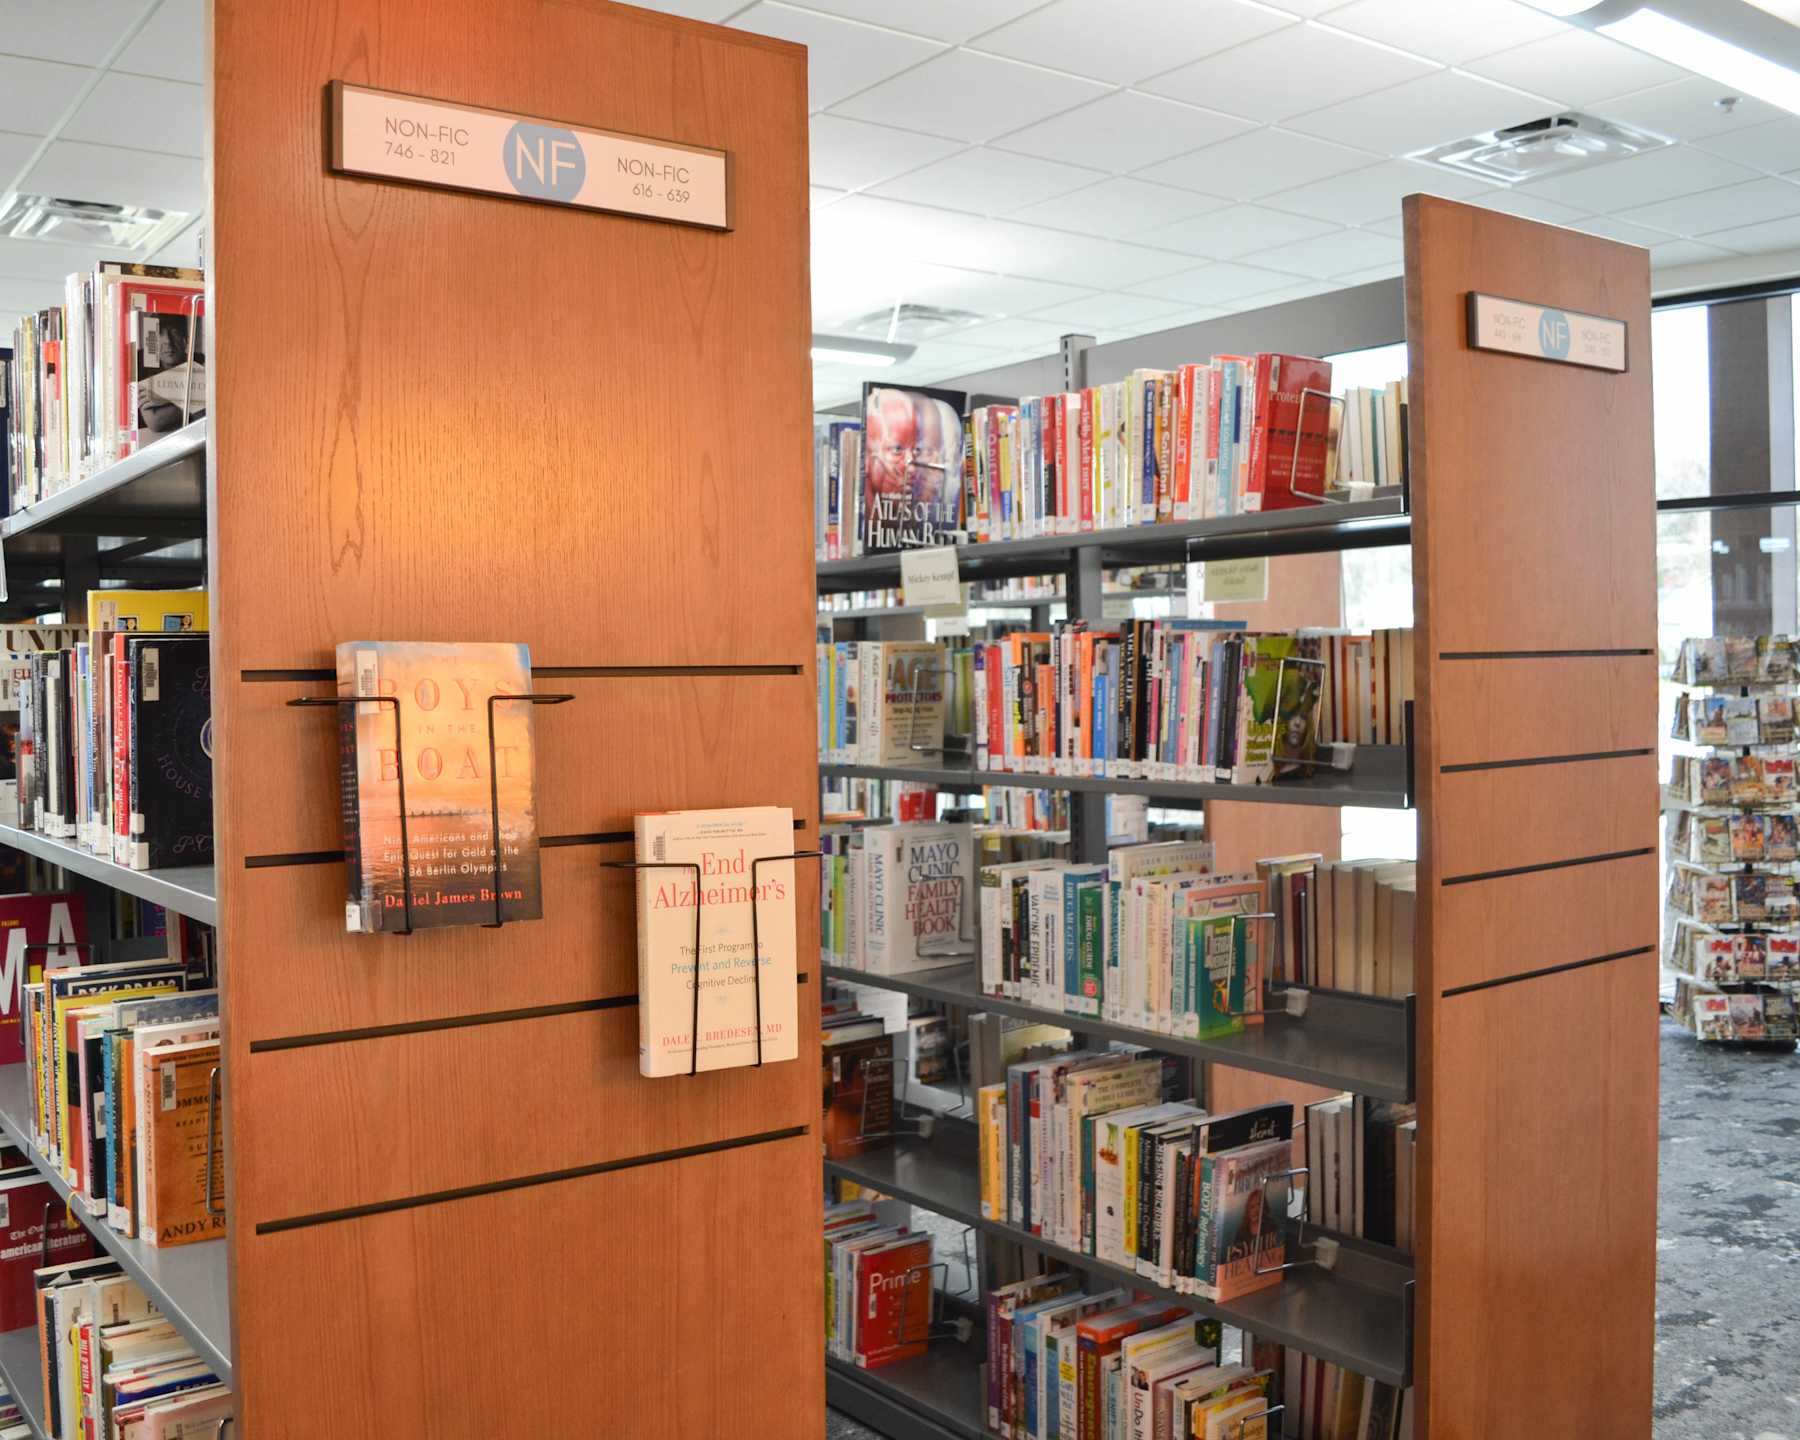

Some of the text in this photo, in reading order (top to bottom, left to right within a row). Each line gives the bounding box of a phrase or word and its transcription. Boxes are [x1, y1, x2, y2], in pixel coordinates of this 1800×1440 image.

[385, 116, 470, 147] NON-FIC
[385, 141, 414, 159] 746
[430, 148, 456, 166] 821
[514, 132, 577, 187] NF
[617, 157, 691, 185] NON-FIC
[632, 183, 653, 199] 616
[666, 188, 691, 204] 639
[1543, 319, 1568, 350] NF
[1160, 431, 1170, 493] Solution
[378, 678, 515, 712] BOYS
[377, 746, 520, 782] BOAT
[413, 831, 466, 844] Americans
[470, 831, 489, 841] and
[443, 847, 457, 859] for
[461, 847, 487, 858] Gold
[503, 846, 520, 856] the
[702, 848, 745, 877] End
[910, 841, 960, 865] MAYO
[426, 863, 457, 876] Berlin
[385, 889, 430, 908] Daiel
[434, 889, 476, 906] James
[654, 877, 786, 910] Alzheimer's
[874, 854, 884, 938] MAYO CLINIC
[907, 879, 961, 901] FAMILY
[913, 916, 956, 937] BOOK
[718, 941, 752, 955] Program
[1030, 894, 1040, 989] VACCINE EPIDEMIC
[712, 957, 731, 970] and
[662, 1033, 690, 1047] DALE
[766, 1023, 782, 1034] MD
[1202, 1181, 1211, 1214] BODY
[159, 1218, 208, 1241] ANDY
